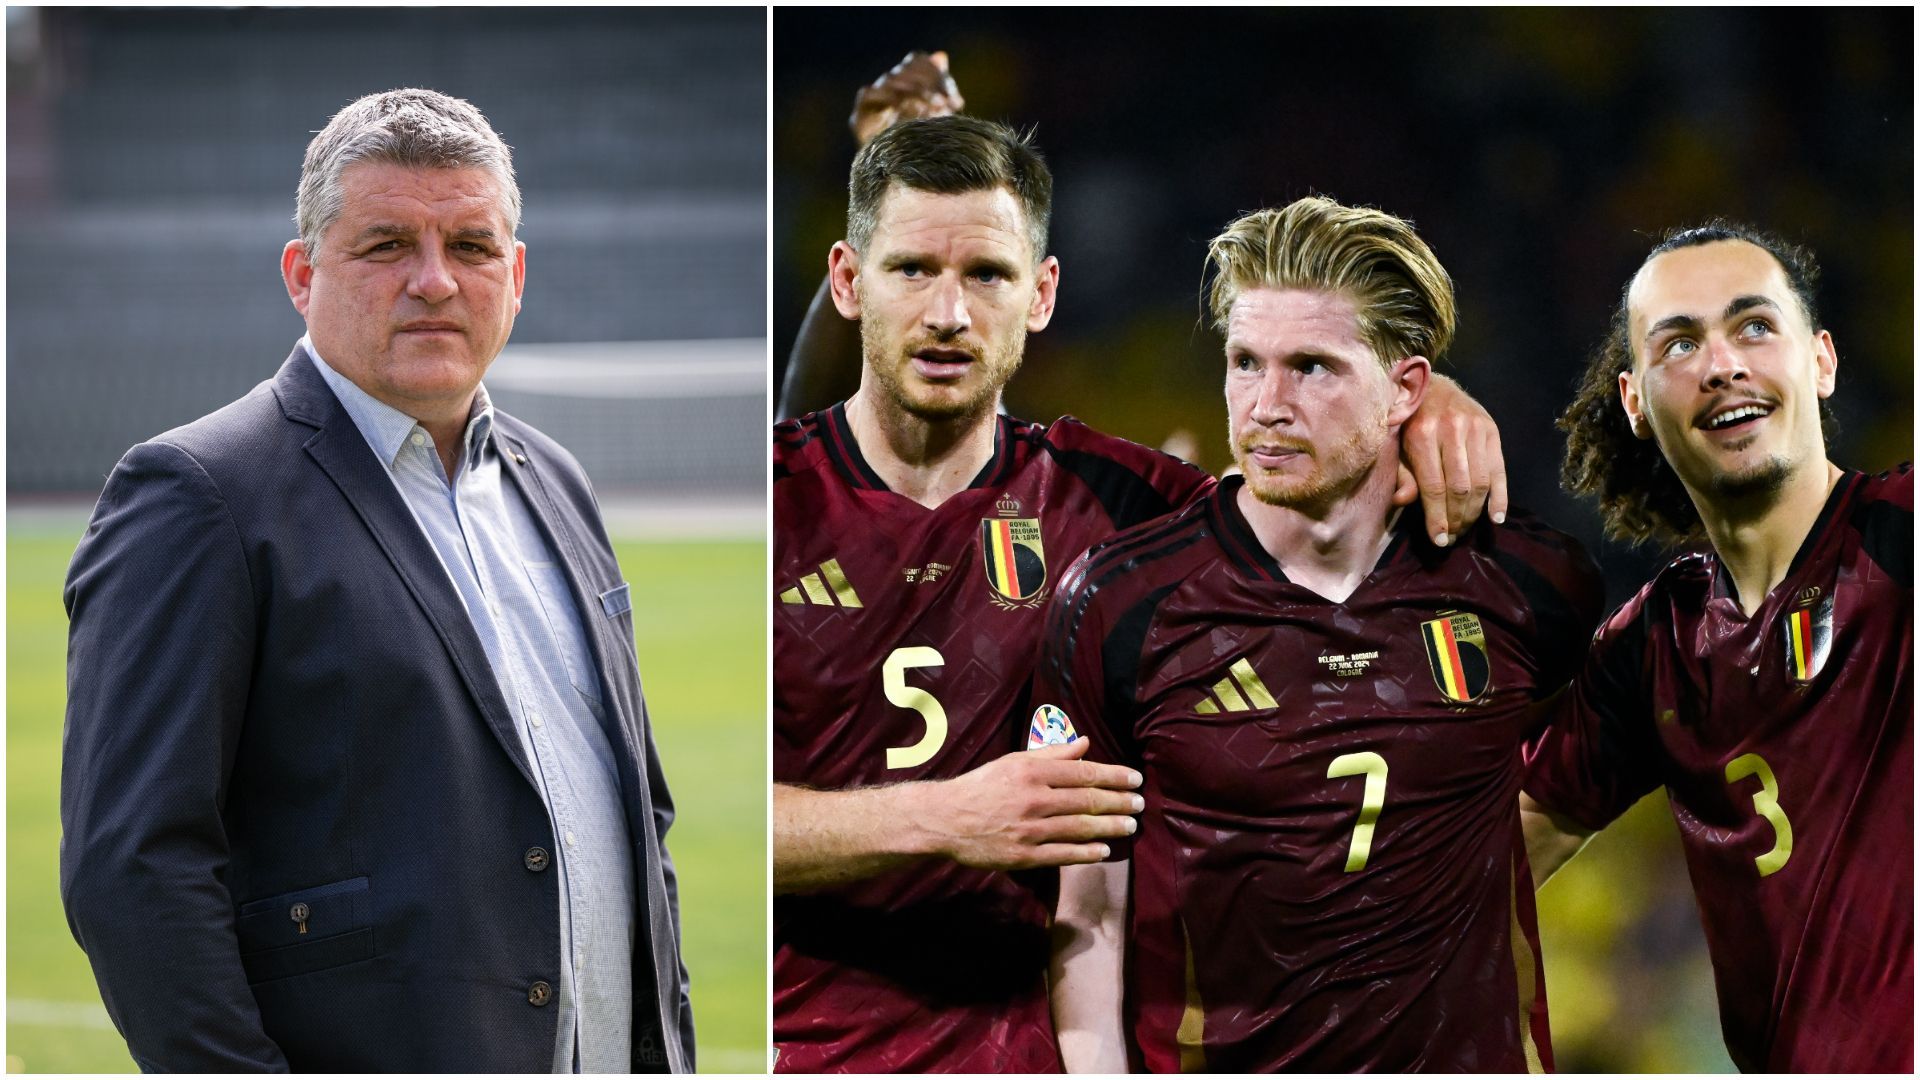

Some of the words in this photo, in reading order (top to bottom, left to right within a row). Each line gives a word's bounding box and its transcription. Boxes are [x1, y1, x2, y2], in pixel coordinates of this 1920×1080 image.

[1010, 527, 1039, 535] BELGIAN
[1450, 616, 1471, 625] ROYAL
[1452, 621, 1479, 632] BELGIAN
[1318, 654, 1345, 664] BELGIUM
[1351, 651, 1379, 661] ROMANIA
[1328, 663, 1337, 671] 22
[1338, 661, 1353, 670] JUNE
[1353, 660, 1370, 669] 2024
[1336, 668, 1363, 677] COLOGNE
[882, 645, 948, 770] 5
[1326, 751, 1389, 873] 7
[1724, 752, 1794, 878] 3
